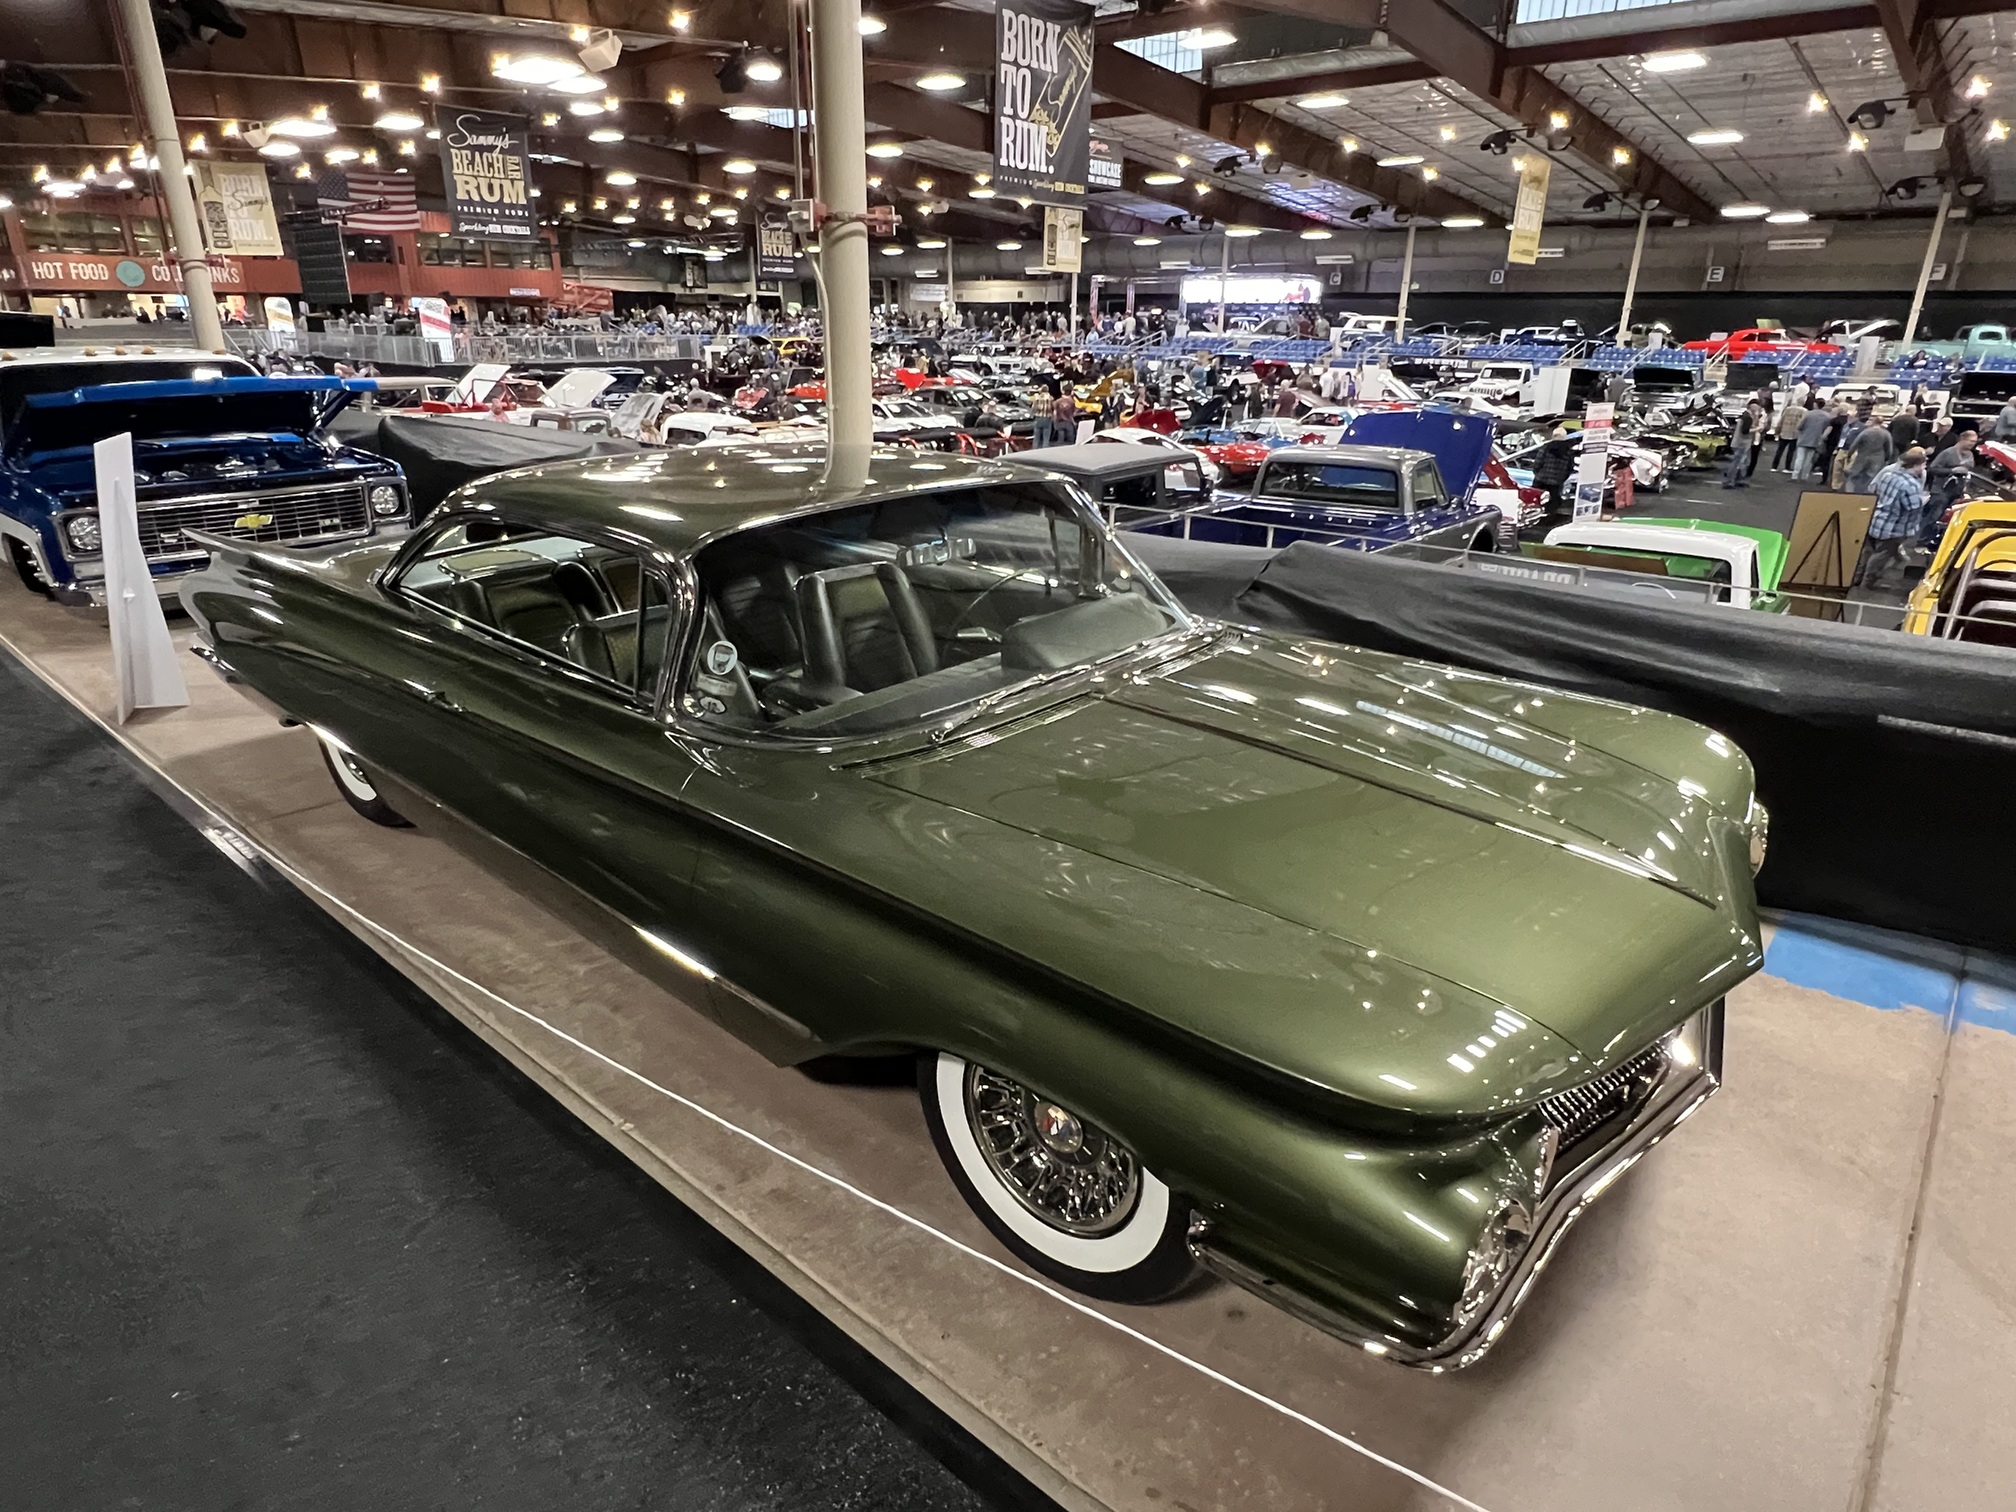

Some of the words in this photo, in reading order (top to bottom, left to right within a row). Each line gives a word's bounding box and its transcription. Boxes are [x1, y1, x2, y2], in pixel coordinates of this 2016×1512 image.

[1001, 8, 1061, 74] BORN
[1001, 63, 1032, 119] TO
[446, 114, 519, 156] Sammy's
[1000, 116, 1055, 174] RUM.
[450, 148, 505, 178] BEACH
[507, 155, 524, 179] BAR
[1089, 158, 1122, 179] SHOWCASE
[453, 174, 528, 205] RUM
[457, 205, 500, 215] PREMIUM
[32, 261, 65, 280] HOT
[69, 263, 109, 281] FOOD
[151, 265, 184, 282] CO
[206, 266, 241, 284] INKS
[1331, 273, 1340, 284] C
[1493, 271, 1502, 282] D
[1710, 267, 1721, 280] E
[1929, 264, 1943, 279] F
